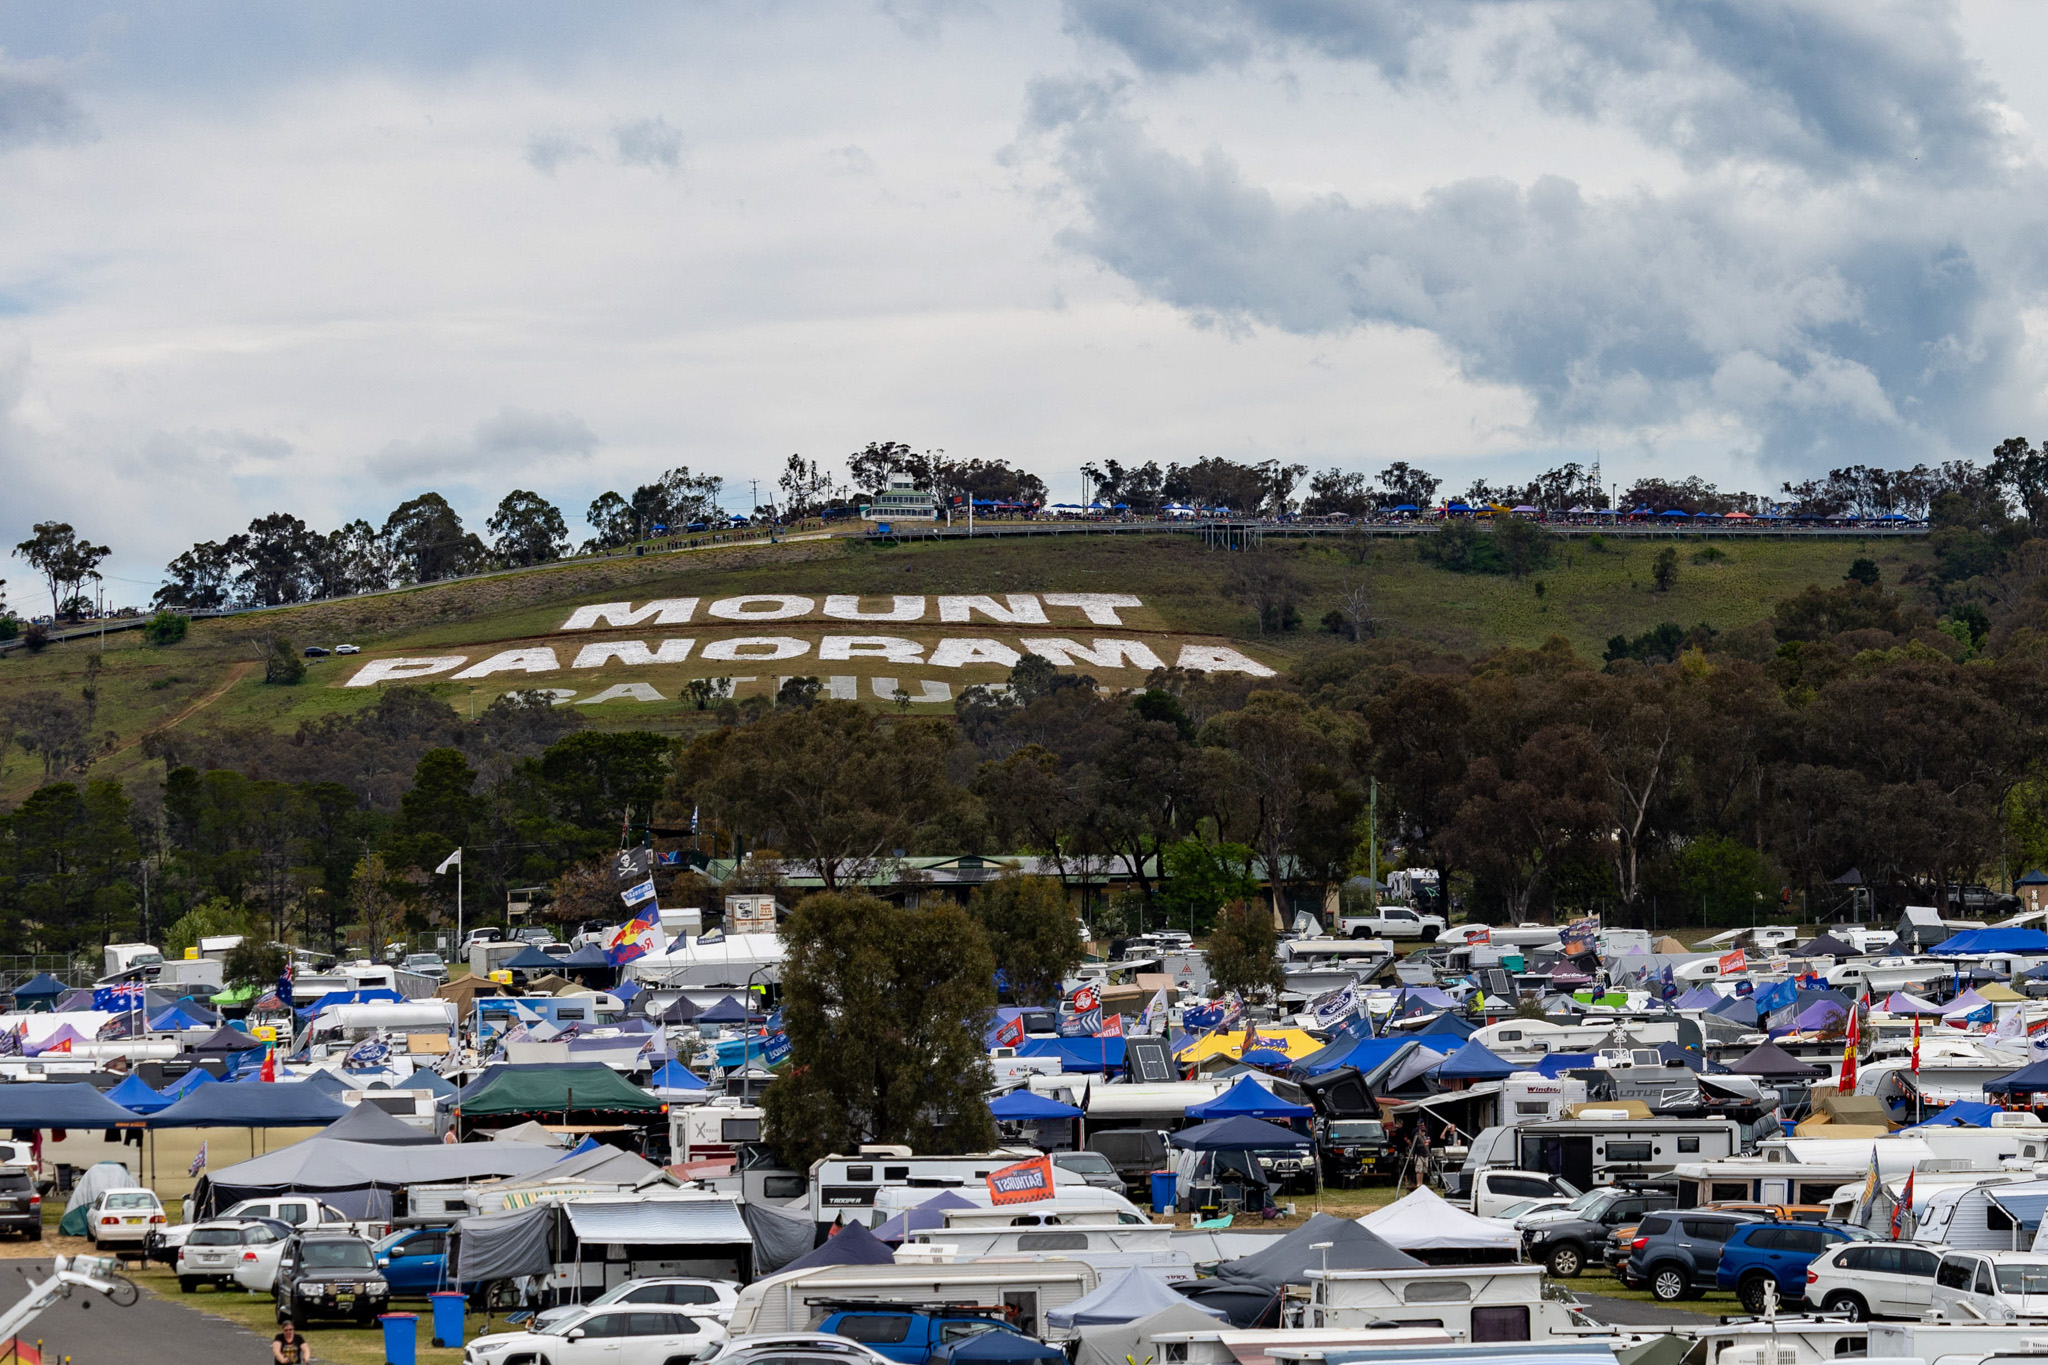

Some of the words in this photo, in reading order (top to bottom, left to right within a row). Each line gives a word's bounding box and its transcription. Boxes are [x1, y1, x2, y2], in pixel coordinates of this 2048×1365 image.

[560, 593, 1143, 630] MOUNT
[344, 636, 1278, 688] PANORAMA
[1619, 1089, 1661, 1098] LOTUS
